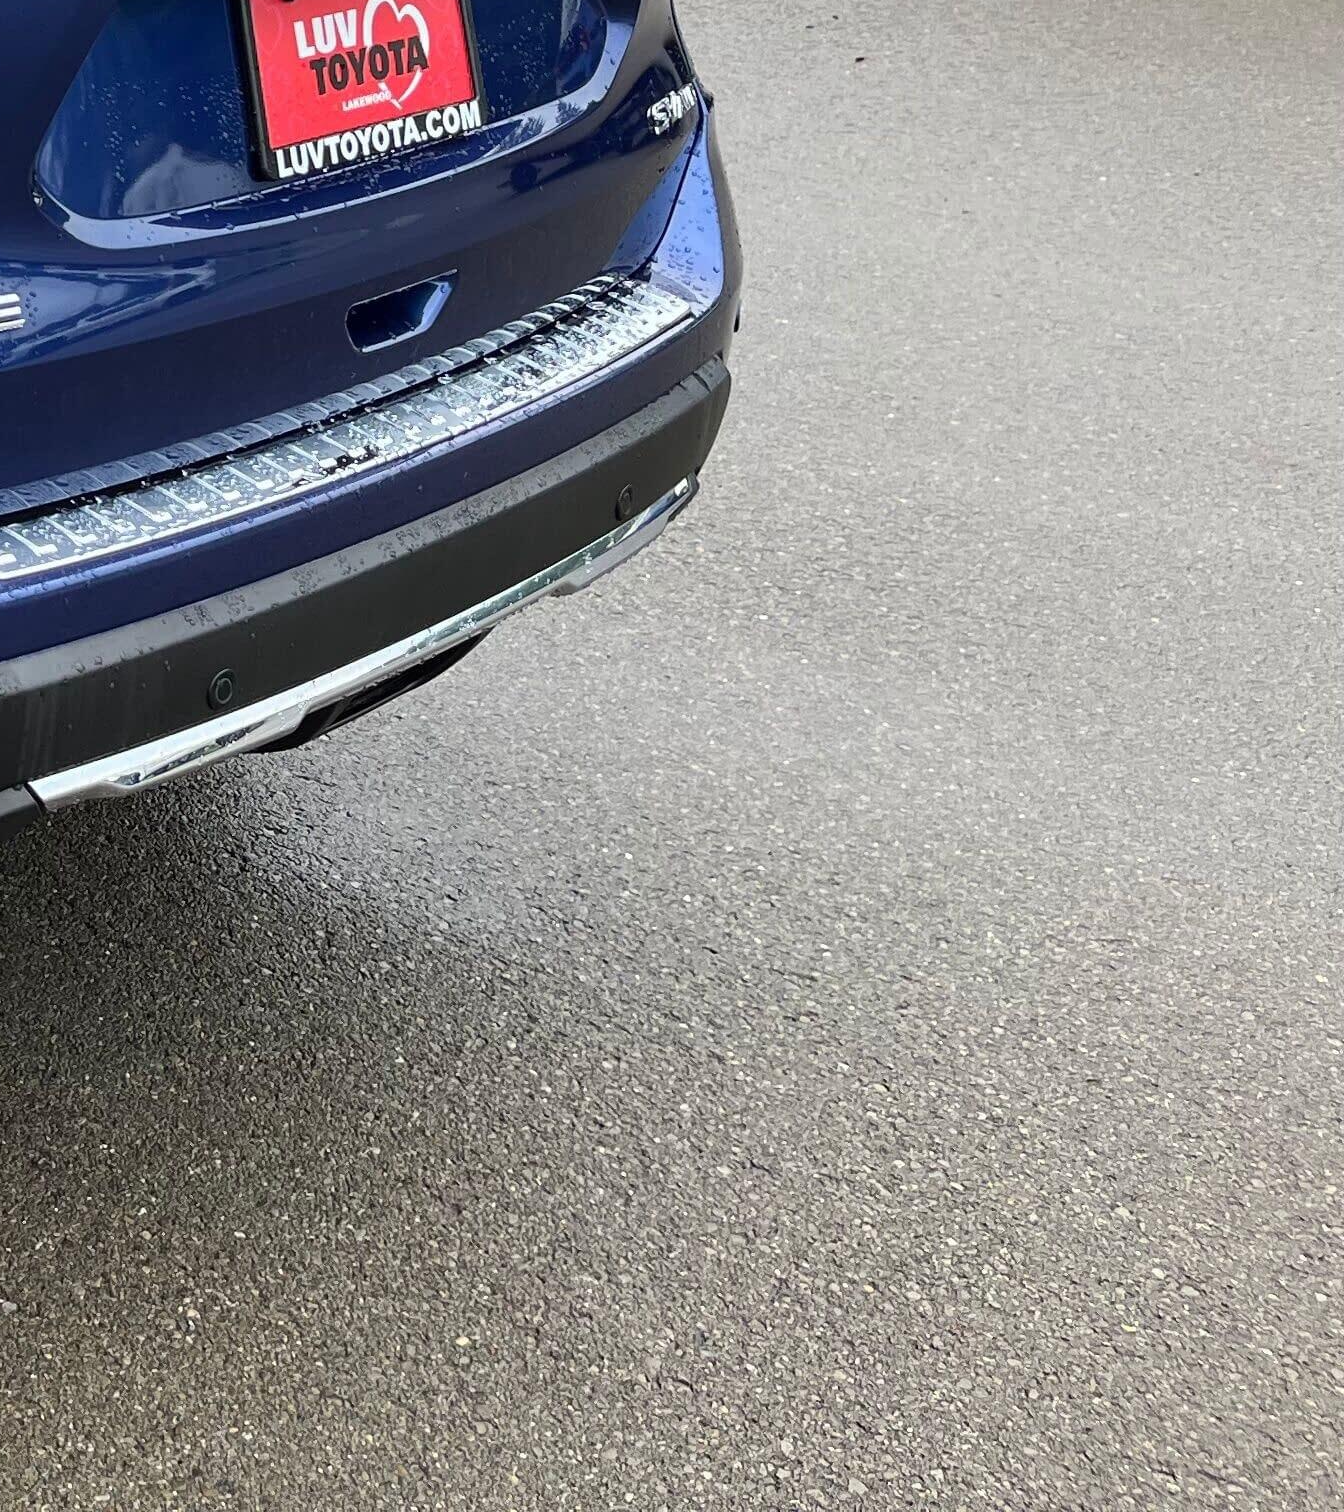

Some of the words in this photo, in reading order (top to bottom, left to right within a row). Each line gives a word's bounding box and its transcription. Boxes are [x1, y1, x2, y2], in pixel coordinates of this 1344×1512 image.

[293, 8, 358, 60] LUV
[309, 35, 429, 96] TOYOTA
[342, 89, 392, 111] LAKEWOOD
[275, 99, 482, 179] LUVTOYOTA.COM
